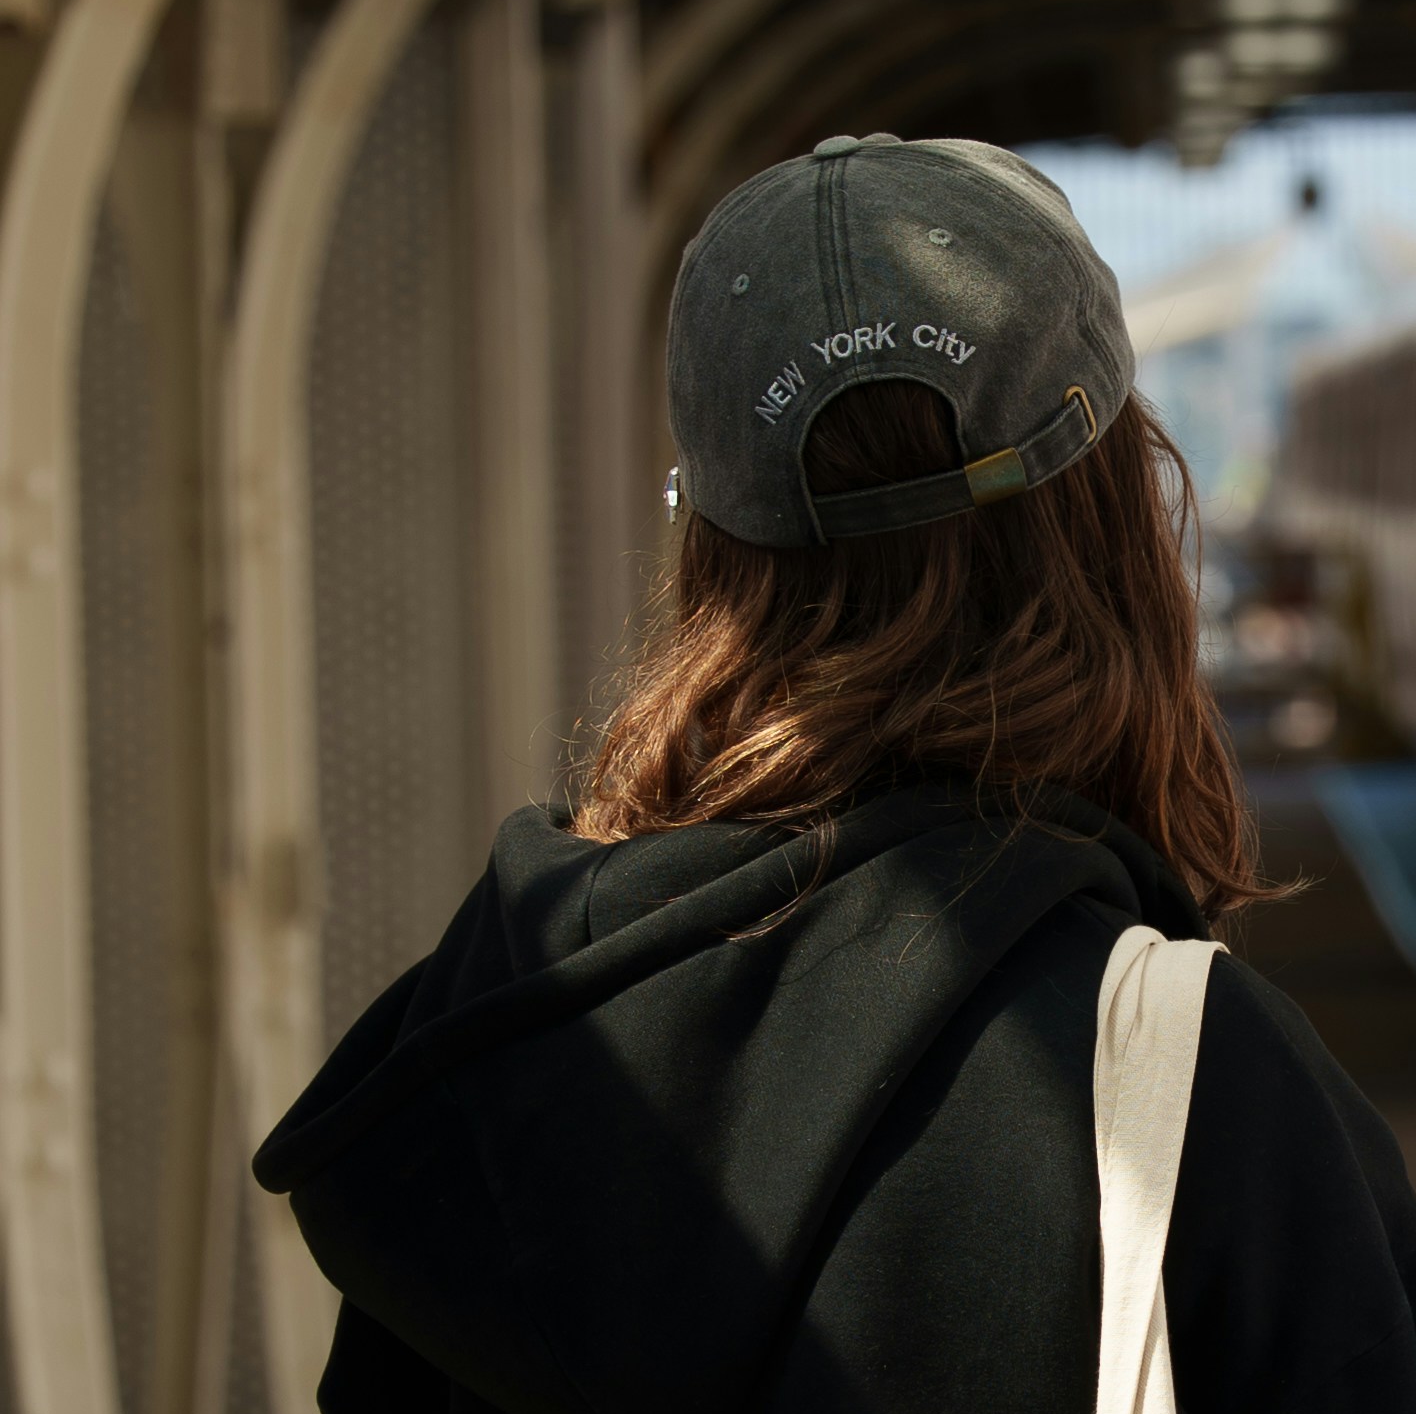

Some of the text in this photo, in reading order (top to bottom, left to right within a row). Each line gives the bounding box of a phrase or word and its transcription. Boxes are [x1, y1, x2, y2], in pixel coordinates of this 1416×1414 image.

[754, 321, 977, 427] NEW YORK City
